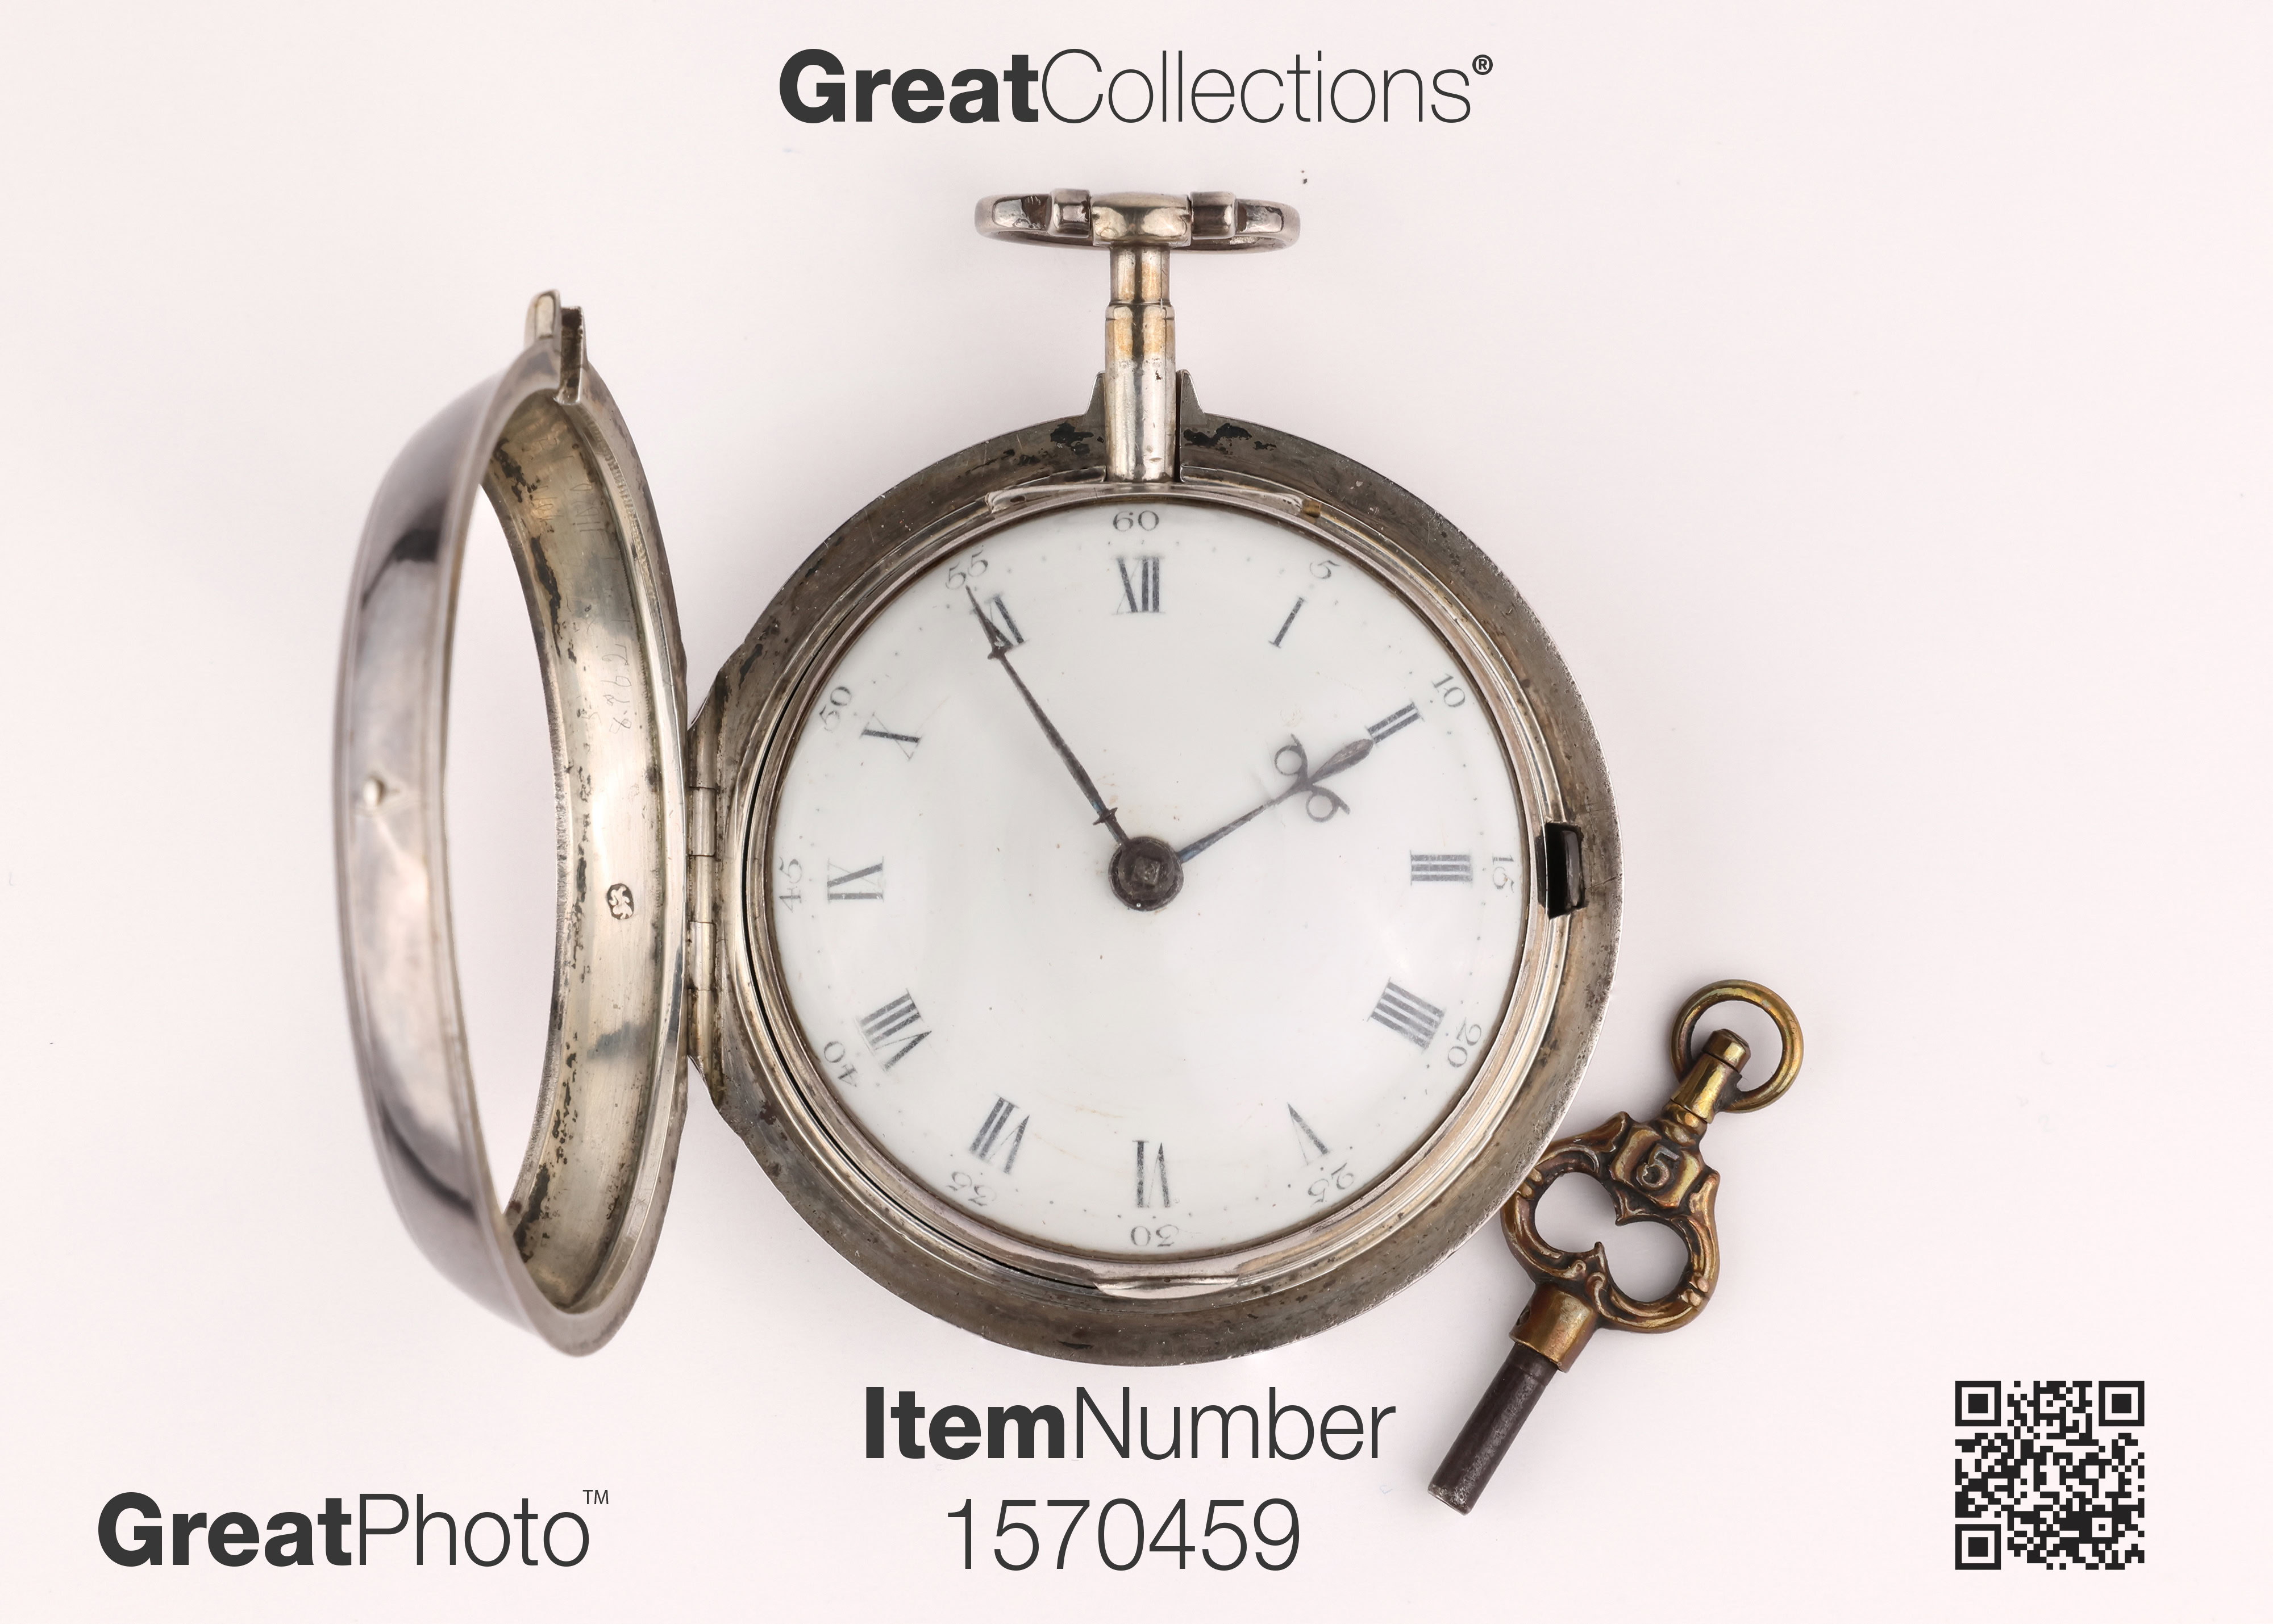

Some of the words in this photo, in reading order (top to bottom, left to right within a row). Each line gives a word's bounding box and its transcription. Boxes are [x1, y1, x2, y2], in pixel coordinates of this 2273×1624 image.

[1113, 510, 1159, 532] 60
[946, 549, 988, 589] 55
[1111, 553, 1165, 614] XII
[1309, 560, 1340, 580] 5
[1268, 597, 1307, 648] I
[819, 686, 852, 733] 50
[1432, 673, 1466, 708] 10
[860, 711, 922, 760] X
[1366, 700, 1424, 744] II
[779, 856, 802, 913] 45
[827, 856, 884, 903] IX
[1410, 850, 1473, 887] III
[1492, 852, 1514, 893] 15
[855, 988, 932, 1072] VIII
[1367, 977, 1447, 1054] IIII
[823, 1040, 857, 1088] 40
[1447, 1018, 1482, 1068] 20
[968, 1094, 1030, 1176] VII
[1288, 1102, 1330, 1165] V
[946, 1171, 998, 1207] 35
[1132, 1139, 1172, 1208] VI
[1308, 1162, 1355, 1204] 25
[1635, 1143, 1681, 1190] 5
[1130, 1224, 1180, 1248] 30
